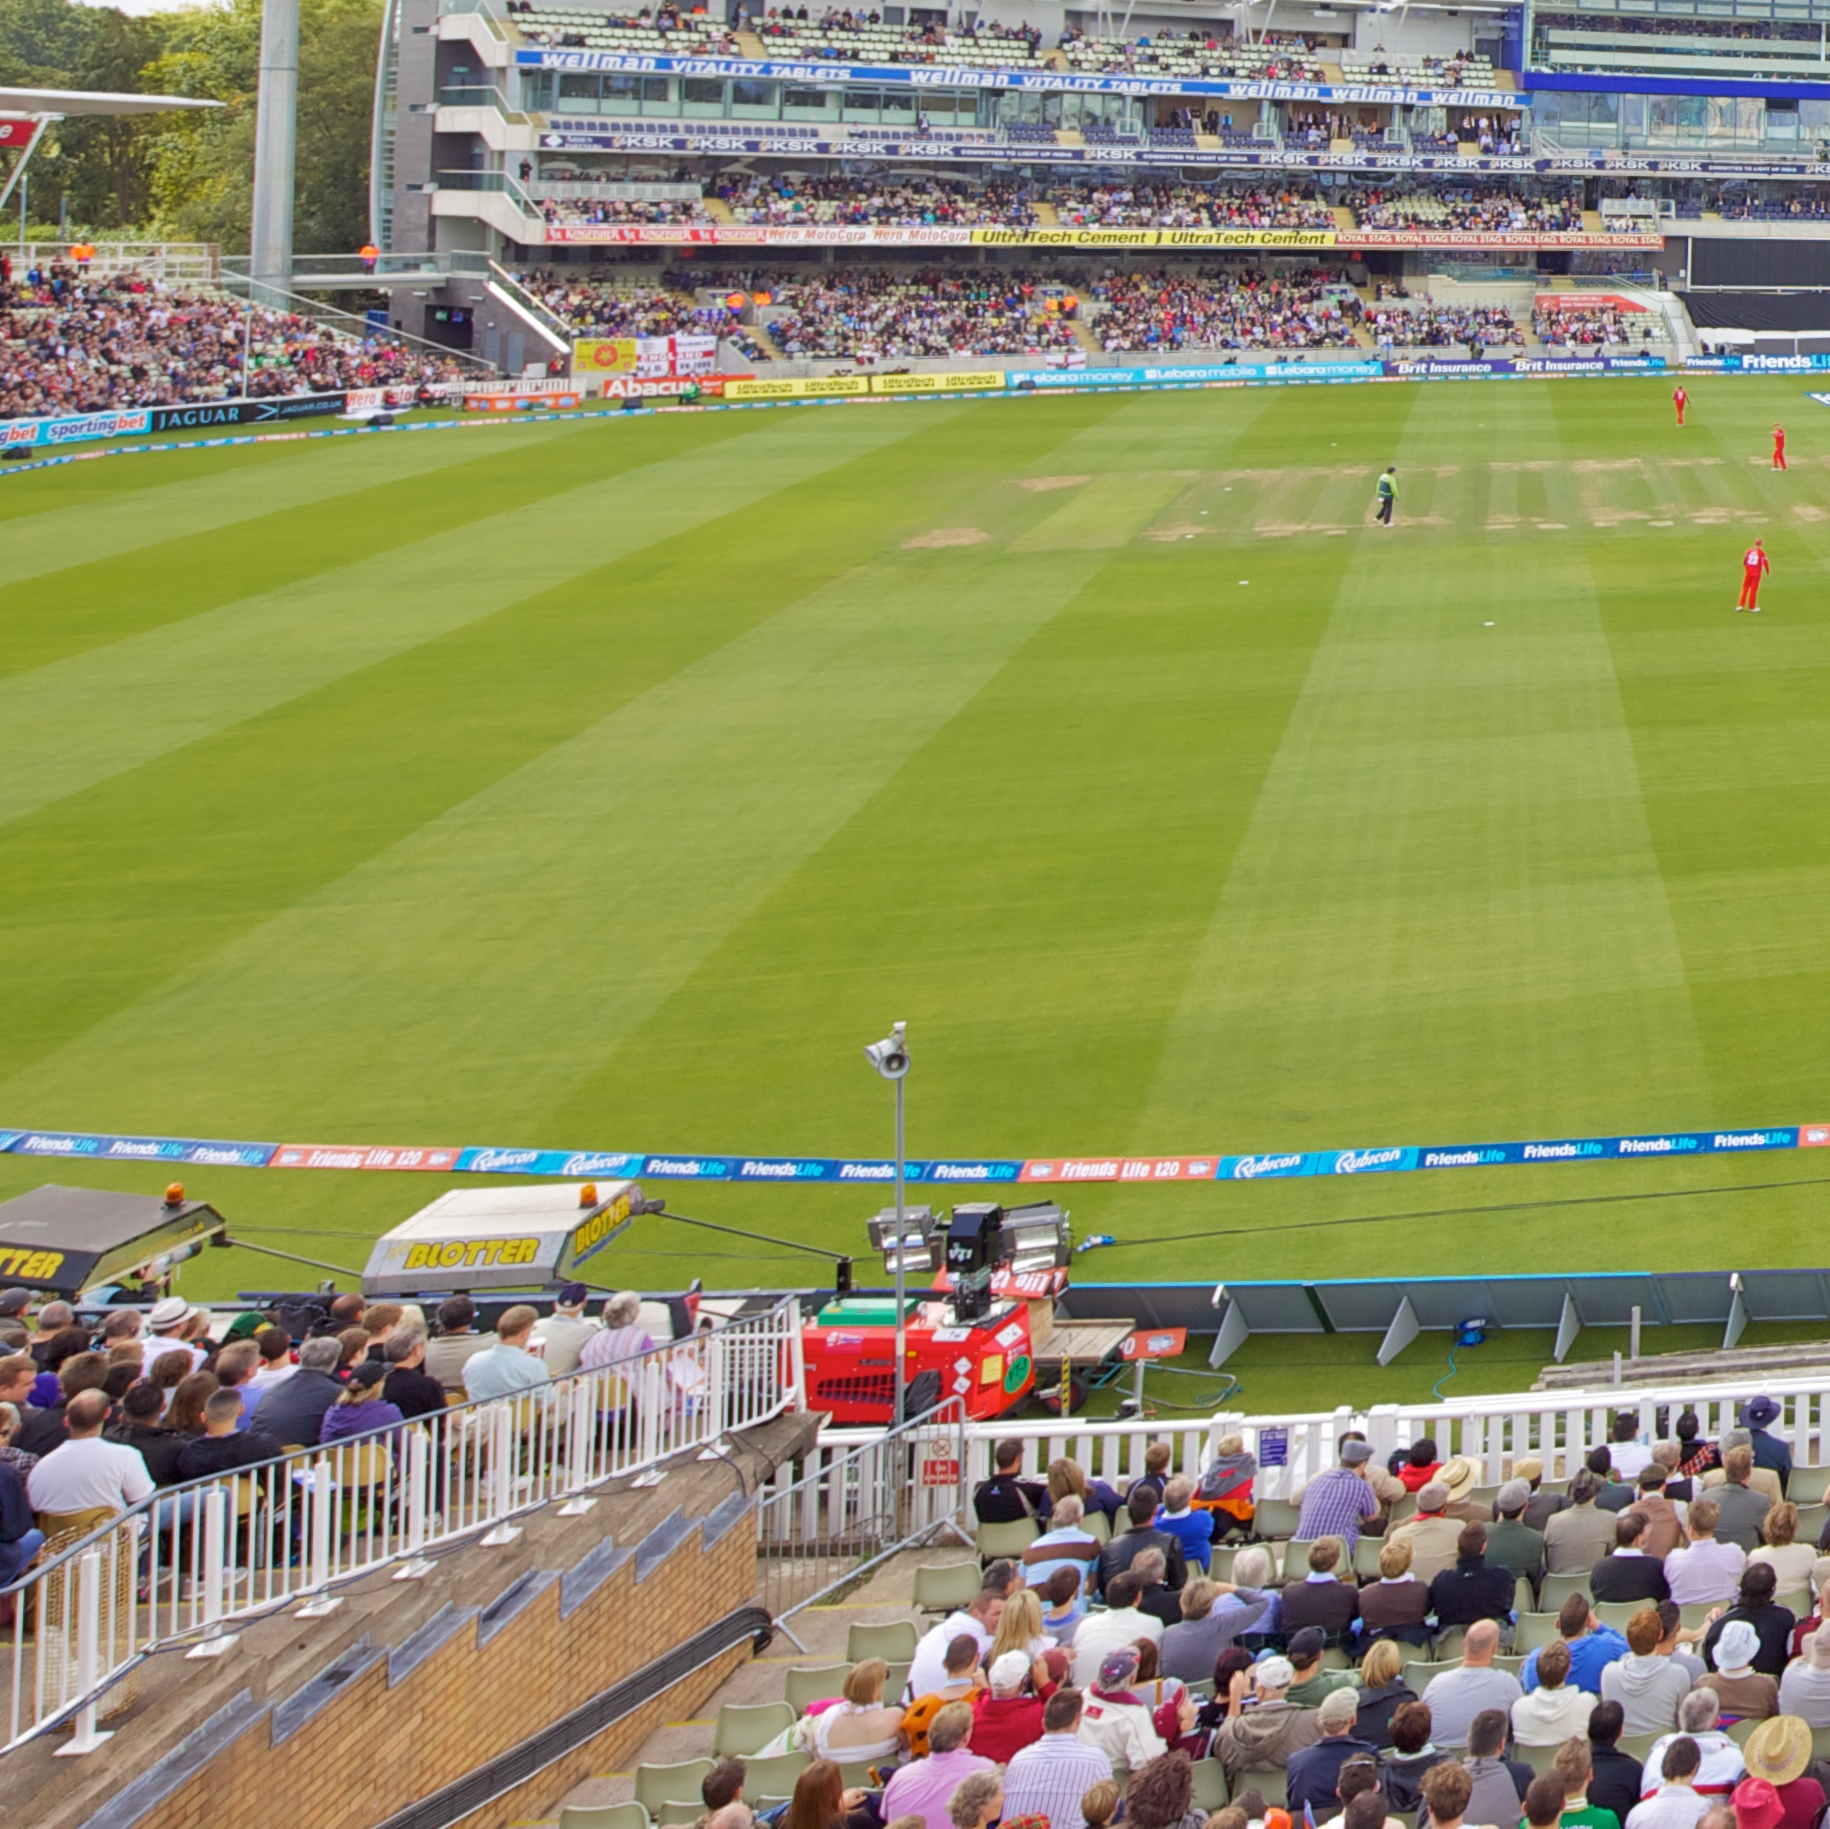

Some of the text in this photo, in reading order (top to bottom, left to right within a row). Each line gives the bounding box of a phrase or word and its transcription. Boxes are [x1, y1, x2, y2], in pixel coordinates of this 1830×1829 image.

[671, 60, 764, 76] VITALITY
[771, 65, 851, 80] TABLETS
[1022, 75, 1105, 90] VITALITY
[1110, 81, 1182, 93] TABLETS
[627, 137, 673, 147] KSK
[774, 141, 818, 152] KSK
[911, 144, 954, 156] KSK
[1269, 153, 1309, 164] KSK
[1079, 232, 1147, 244] Cement
[1171, 232, 1326, 245] UltraTech Cement
[1338, 234, 1392, 243] ROYAL STAG
[1613, 234, 1663, 243] ROYAL STAG
[641, 350, 703, 362] ENGLAND
[1399, 362, 1492, 374] Brit Insurance
[49, 414, 146, 440] sportingbet
[160, 408, 239, 430] JAGUAR
[25, 1134, 99, 1153] FriendsLife
[1620, 1137, 1698, 1155] FriendsLife
[307, 1147, 422, 1169] Friends Life t20
[563, 1153, 628, 1176] Rubicon
[1336, 1149, 1401, 1174] Rubicon
[1426, 1150, 1506, 1167] FriendsLife
[648, 1159, 728, 1175] FriendsLife
[934, 1164, 1016, 1179] FriendsLife
[1061, 1160, 1180, 1178] Friends Life t20
[576, 1192, 631, 1256] BLOTTER
[403, 1237, 542, 1271] BLOTTER
[0, 1248, 65, 1280] TTER
